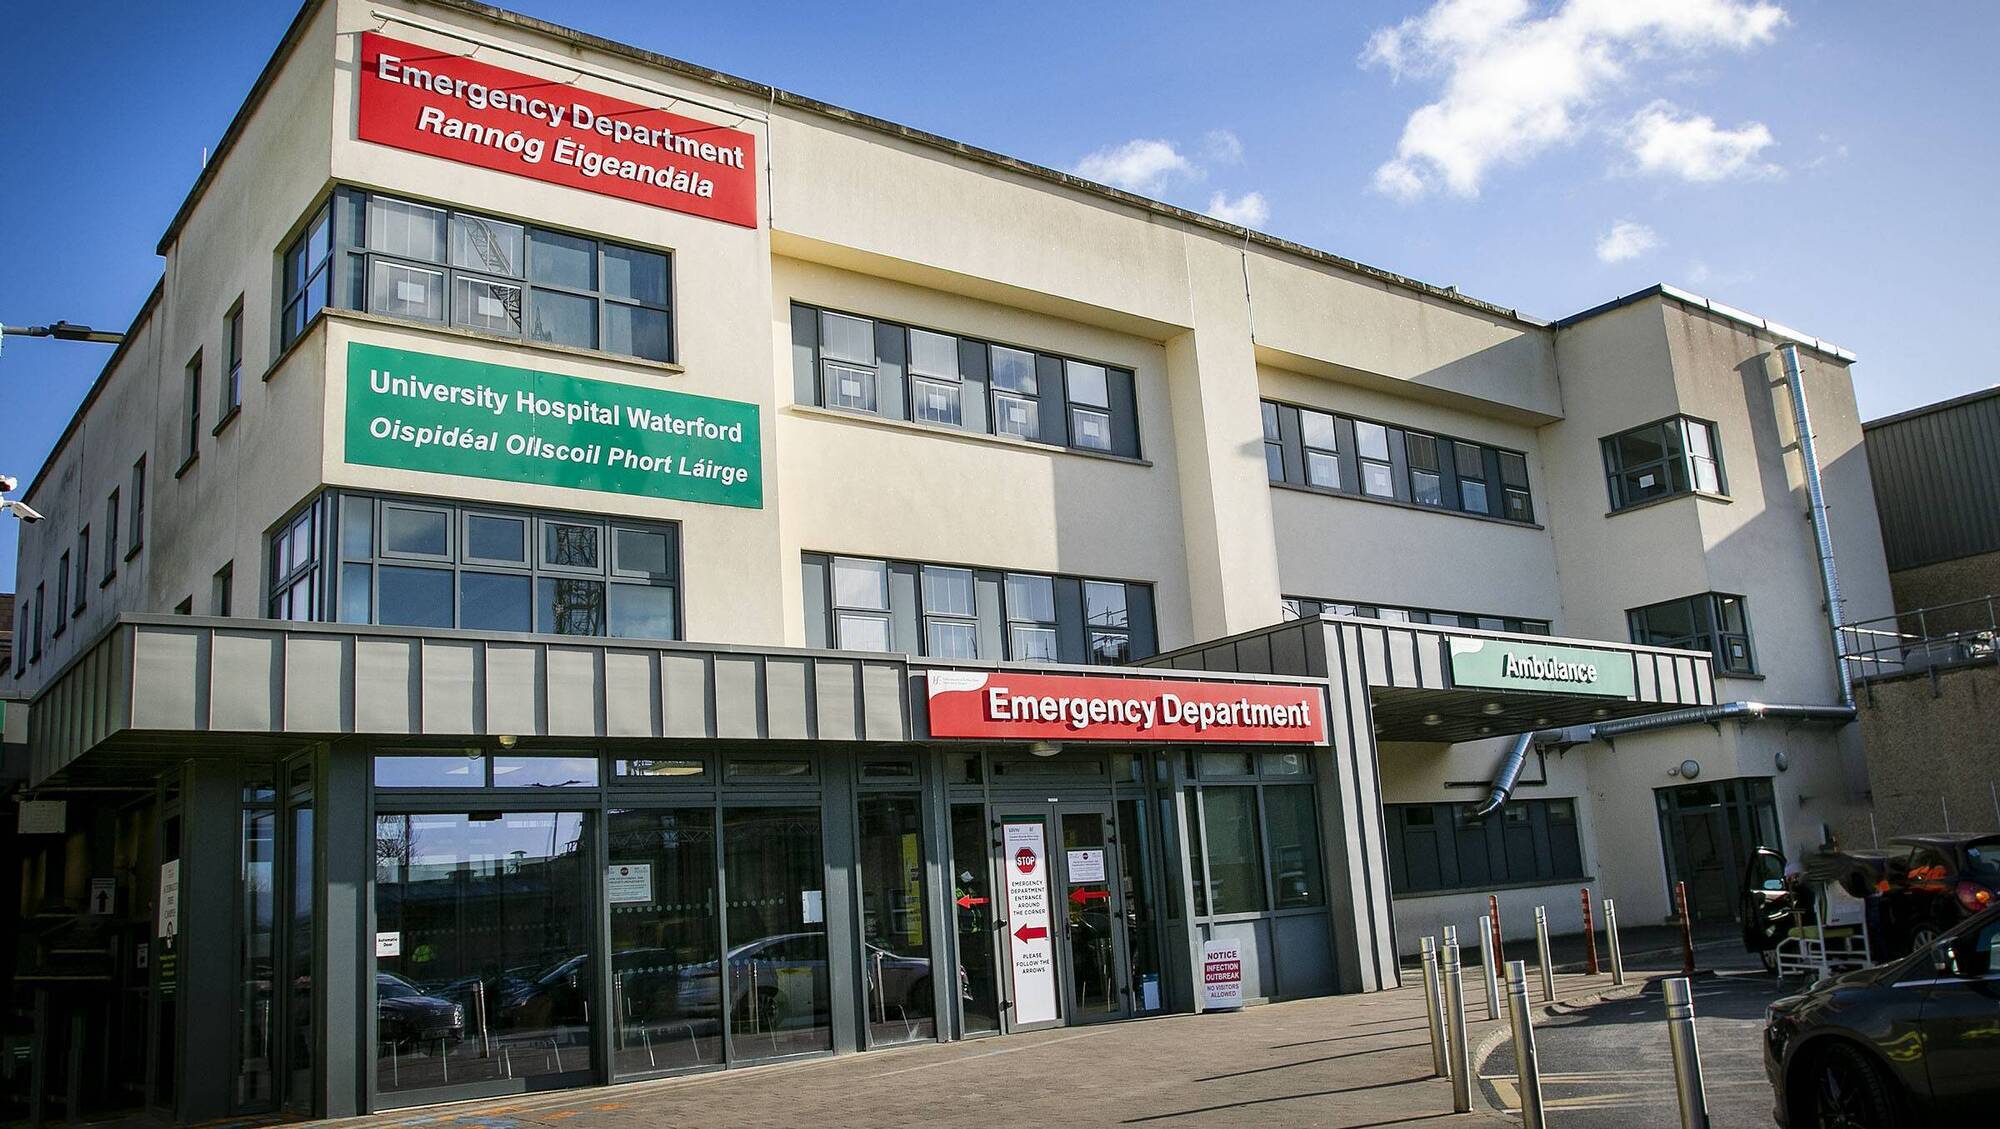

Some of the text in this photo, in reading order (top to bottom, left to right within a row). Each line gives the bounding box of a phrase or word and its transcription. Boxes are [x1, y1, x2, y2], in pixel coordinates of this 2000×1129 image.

[379, 53, 744, 169] Emergency Department
[418, 105, 714, 198] Rannóg Éigeandála
[370, 369, 742, 443] University Hospital Waterford
[369, 416, 748, 486] Oispidéal Ollscoil Phort Láirge
[1506, 651, 1598, 682] Ambulance
[989, 687, 1311, 730] Emergency Department
[1016, 856, 1035, 866] STOP
[1207, 950, 1237, 960] NOTICE
[1205, 971, 1240, 981] OUTBREAK
[1206, 962, 1239, 972] INFECTION
[1210, 990, 1237, 998] ALLOWED
[1216, 983, 1240, 991] VISITORS
